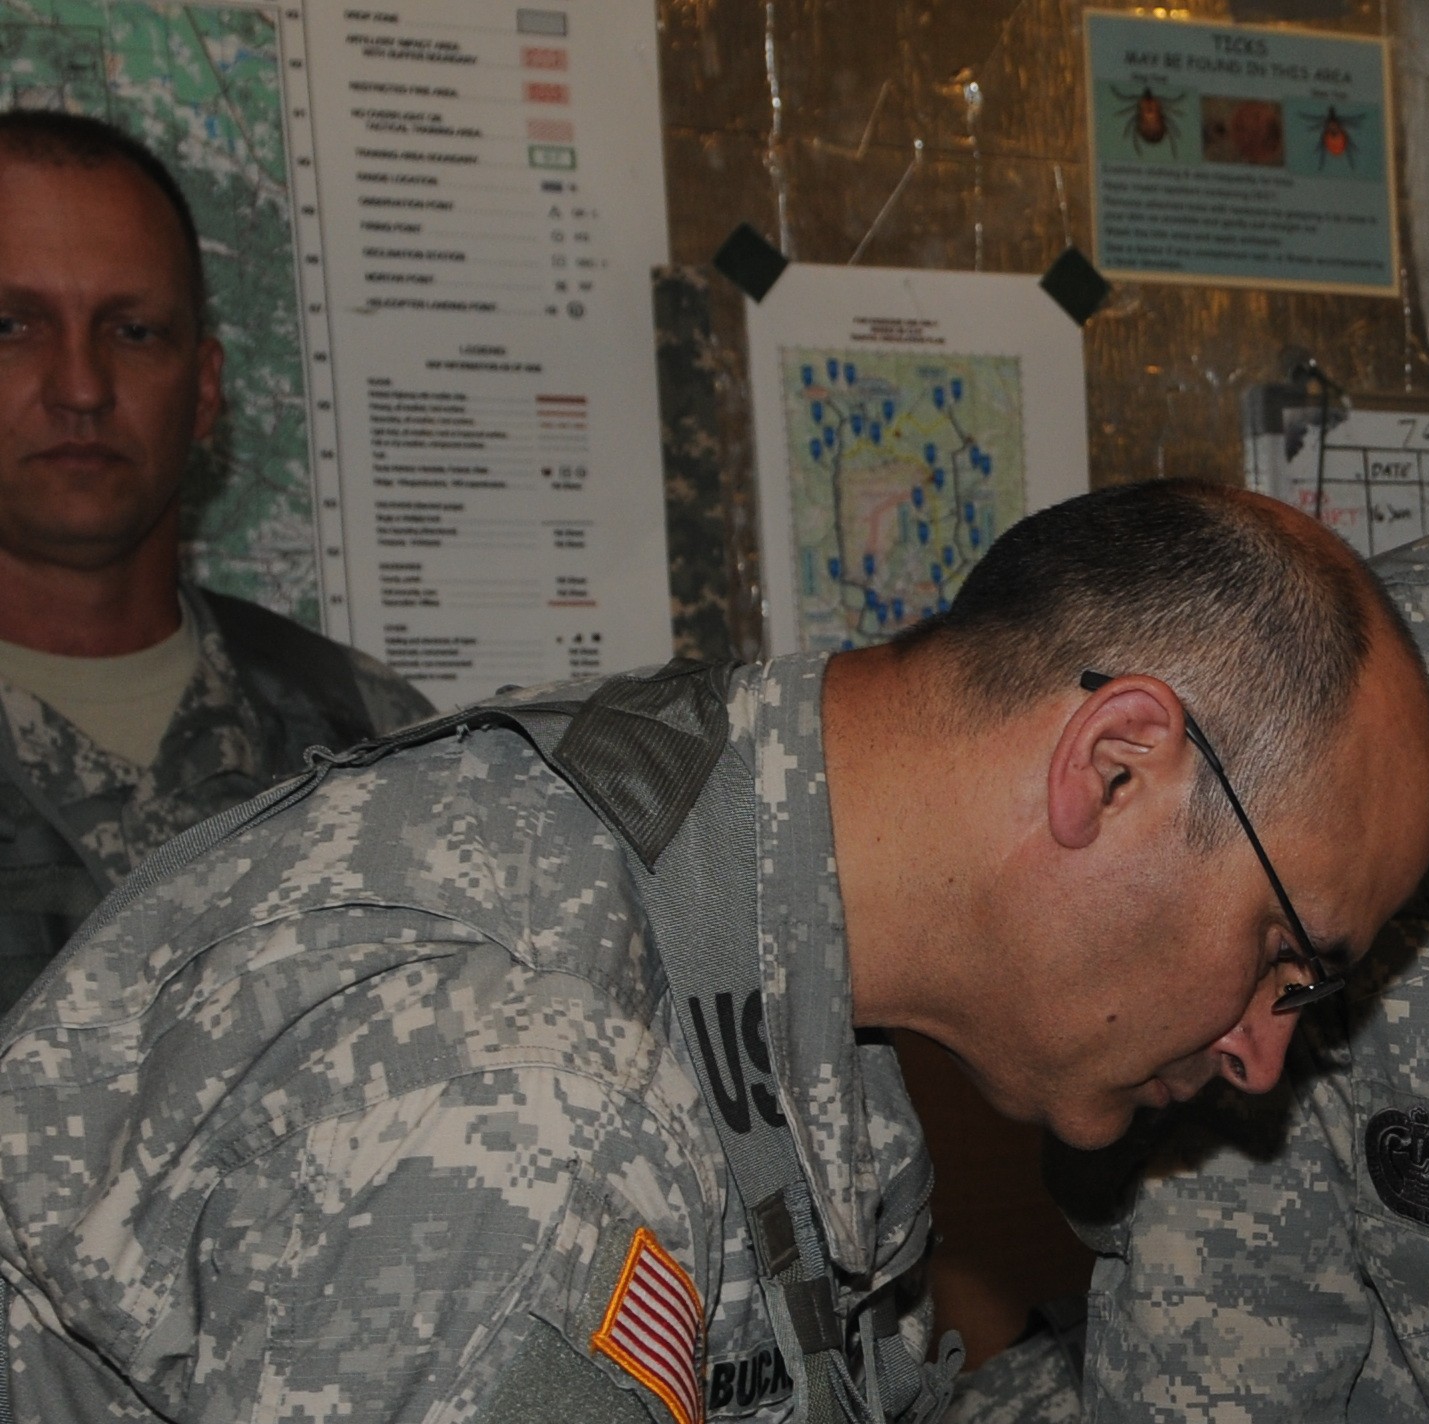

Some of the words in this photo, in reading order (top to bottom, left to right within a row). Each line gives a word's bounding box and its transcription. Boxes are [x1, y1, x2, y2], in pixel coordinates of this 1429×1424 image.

[1212, 33, 1268, 58] TICKS
[1125, 50, 1158, 66] MAY
[1163, 52, 1181, 69] BE
[1187, 55, 1241, 74] FOUND
[1247, 61, 1267, 77] IN
[1272, 63, 1309, 81] THIS
[1313, 67, 1352, 84] AREA
[688, 990, 789, 1134] US
